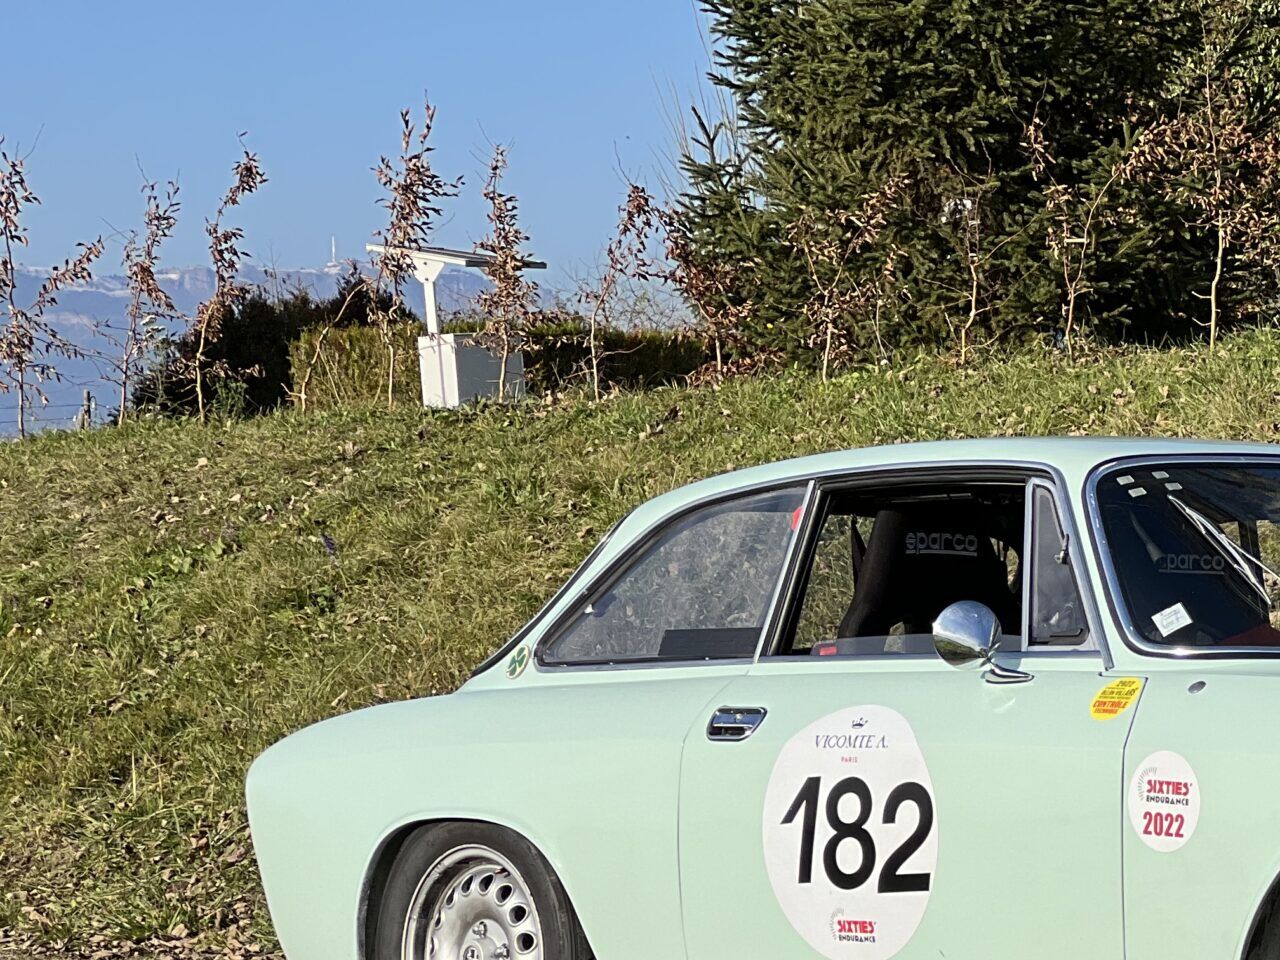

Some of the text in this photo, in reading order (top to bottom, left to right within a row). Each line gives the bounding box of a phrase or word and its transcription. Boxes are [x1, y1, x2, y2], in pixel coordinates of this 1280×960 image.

[905, 532, 978, 555] sparco
[815, 734, 889, 749] VICOMTE A.
[840, 756, 859, 764] PARIS
[1146, 795, 1189, 806] ENDURANCE
[1142, 811, 1185, 838] 2022
[780, 775, 934, 894] 182
[838, 934, 876, 943] ENDURANCE
